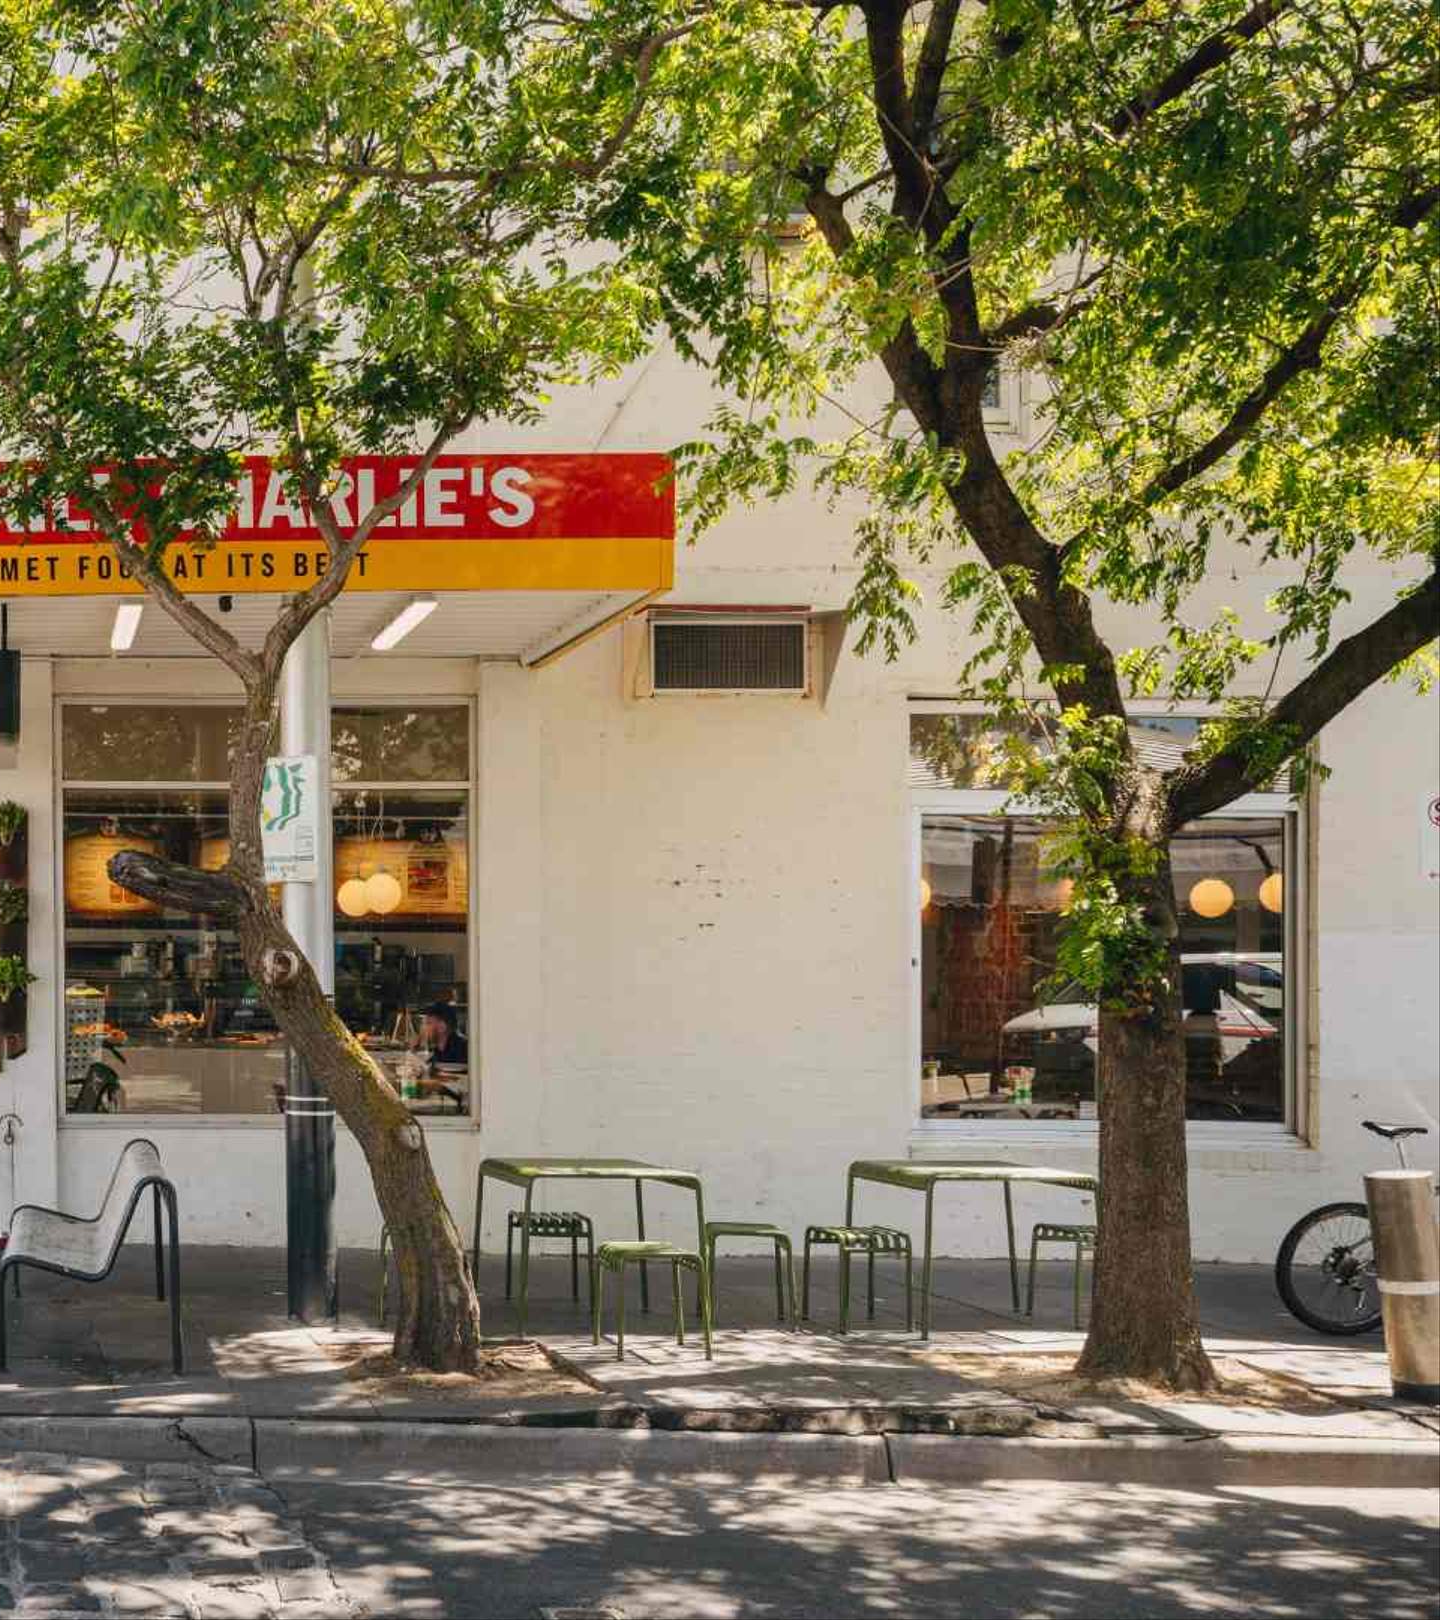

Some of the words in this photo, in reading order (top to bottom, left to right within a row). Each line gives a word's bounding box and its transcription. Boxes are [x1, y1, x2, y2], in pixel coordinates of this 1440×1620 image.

[78, 555, 136, 580] FOO
[174, 554, 205, 578] AT
[227, 552, 275, 577] ITS
[294, 552, 369, 577] BET
